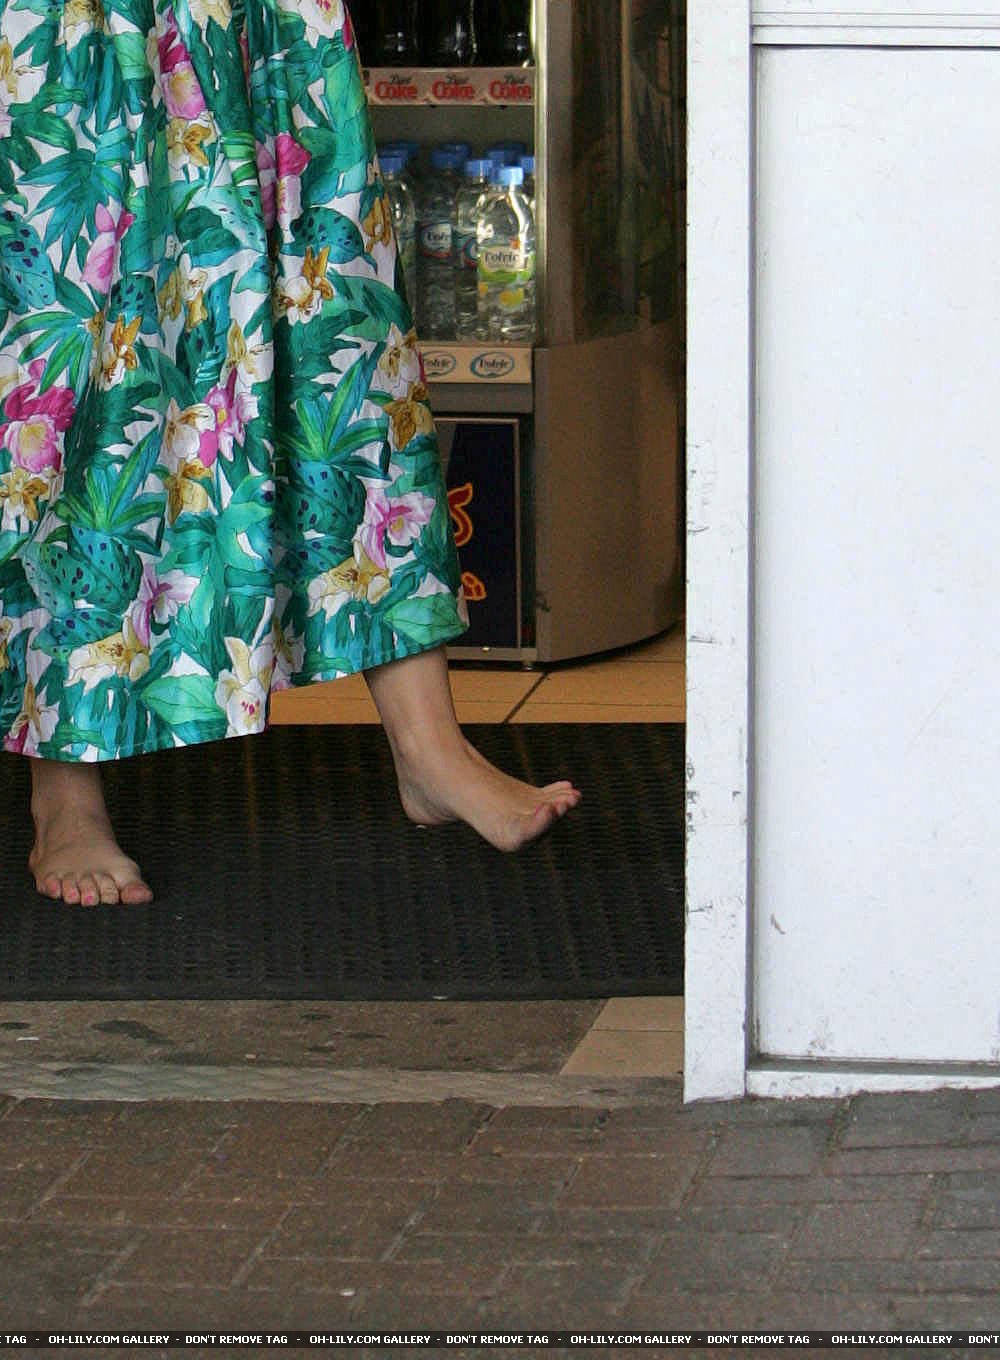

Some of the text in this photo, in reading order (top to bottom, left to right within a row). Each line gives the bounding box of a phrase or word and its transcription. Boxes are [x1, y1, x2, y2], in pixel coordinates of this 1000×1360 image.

[375, 81, 417, 98] Coke
[432, 80, 475, 98] Coke
[489, 80, 532, 99] Coke
[479, 359, 508, 368] Volvic
